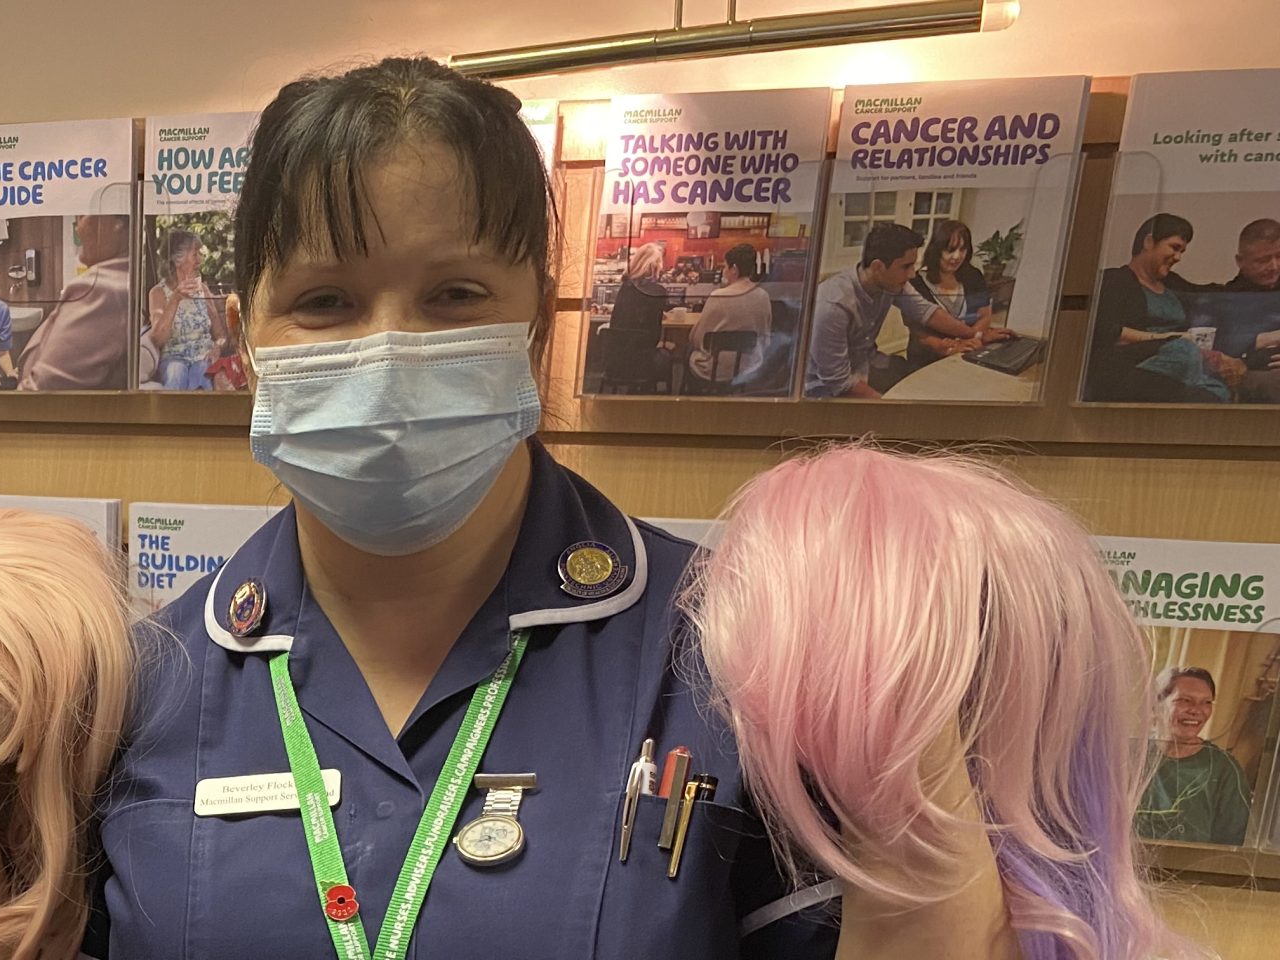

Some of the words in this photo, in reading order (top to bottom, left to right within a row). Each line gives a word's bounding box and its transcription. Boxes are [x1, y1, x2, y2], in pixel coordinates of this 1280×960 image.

[854, 96, 922, 108] MACMILLAN
[854, 106, 883, 115] CANCER
[883, 105, 918, 114] SUPPORT
[623, 107, 683, 118] MACMILLAN
[649, 116, 679, 124] SUPPORT
[158, 127, 210, 137] MACMILLAN
[851, 116, 979, 146] CANCER
[983, 112, 1061, 141] AND
[1152, 129, 1223, 146] Looking
[1228, 128, 1272, 143] after
[620, 131, 720, 154] TALKING
[724, 129, 788, 151] WITH
[157, 146, 215, 171] HOW
[618, 153, 736, 178] SOMEONE
[740, 152, 799, 175] WHO
[851, 143, 1051, 170] RELATIONSHIPS
[1198, 149, 1238, 163] with
[18, 157, 108, 182] CANCER
[151, 173, 203, 195] YOU
[612, 179, 667, 205] HAS
[670, 177, 792, 206] CANCER
[137, 516, 185, 527] MACMILLAN
[137, 534, 171, 552] THE
[137, 571, 177, 589] DIET
[222, 784, 264, 793] Beverley
[199, 797, 244, 806] Macmillan
[245, 793, 279, 805] Support
